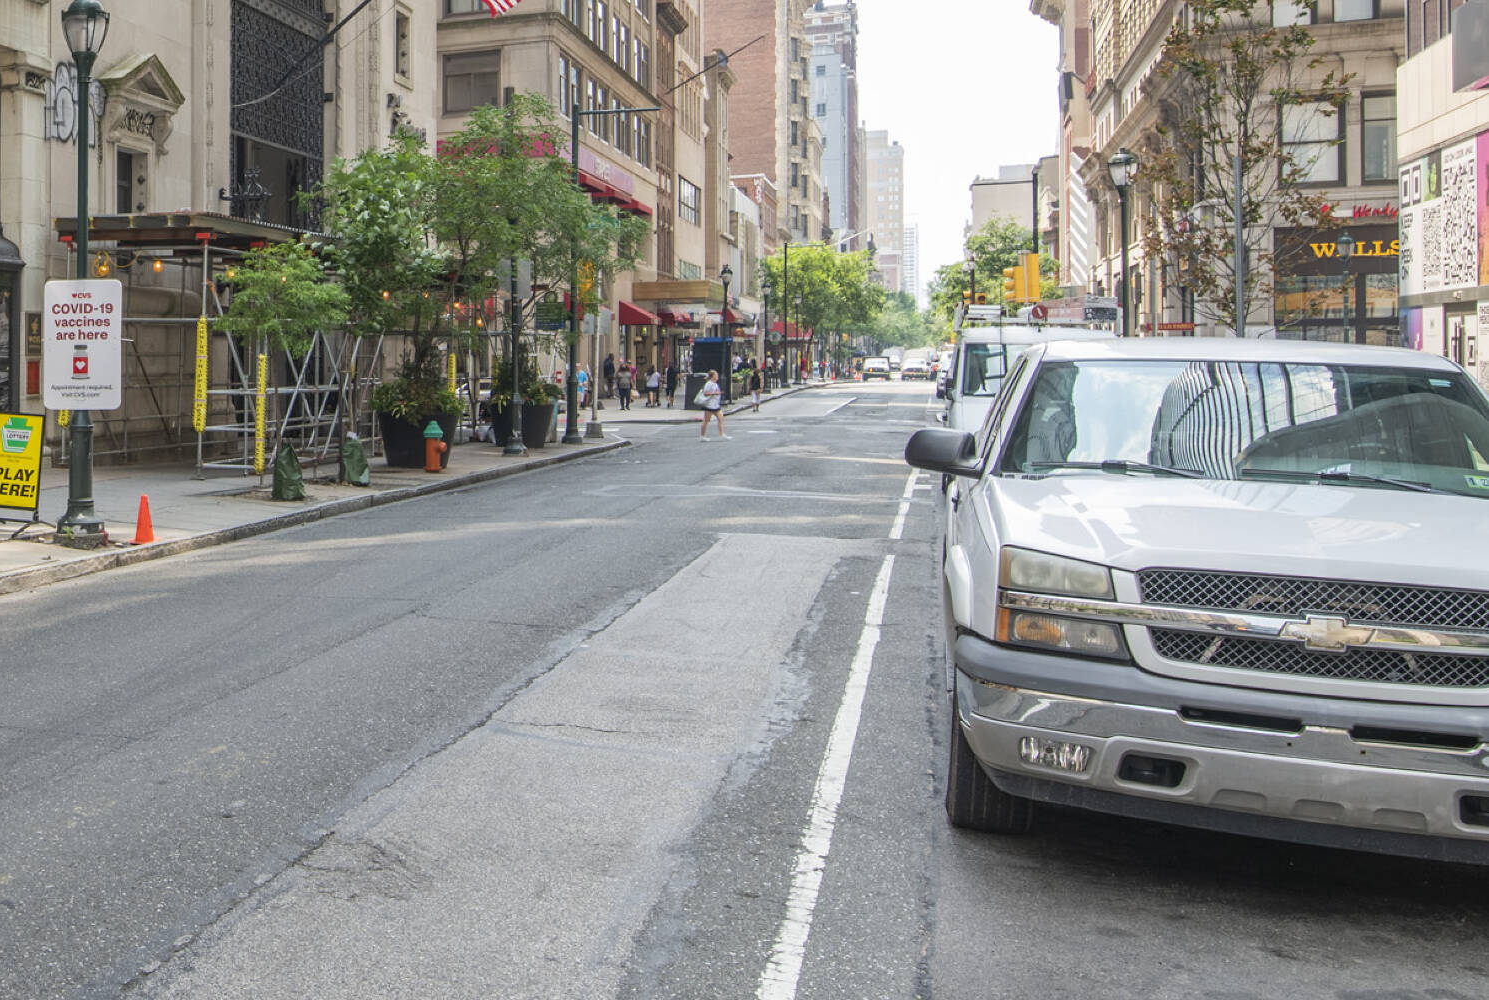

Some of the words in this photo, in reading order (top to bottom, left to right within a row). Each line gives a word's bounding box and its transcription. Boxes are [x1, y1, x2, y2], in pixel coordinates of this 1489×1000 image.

[1309, 240, 1400, 259] WLLS
[51, 303, 114, 315] COVID-19
[54, 315, 111, 328] vaccines
[56, 331, 75, 341] are
[78, 329, 108, 341] here
